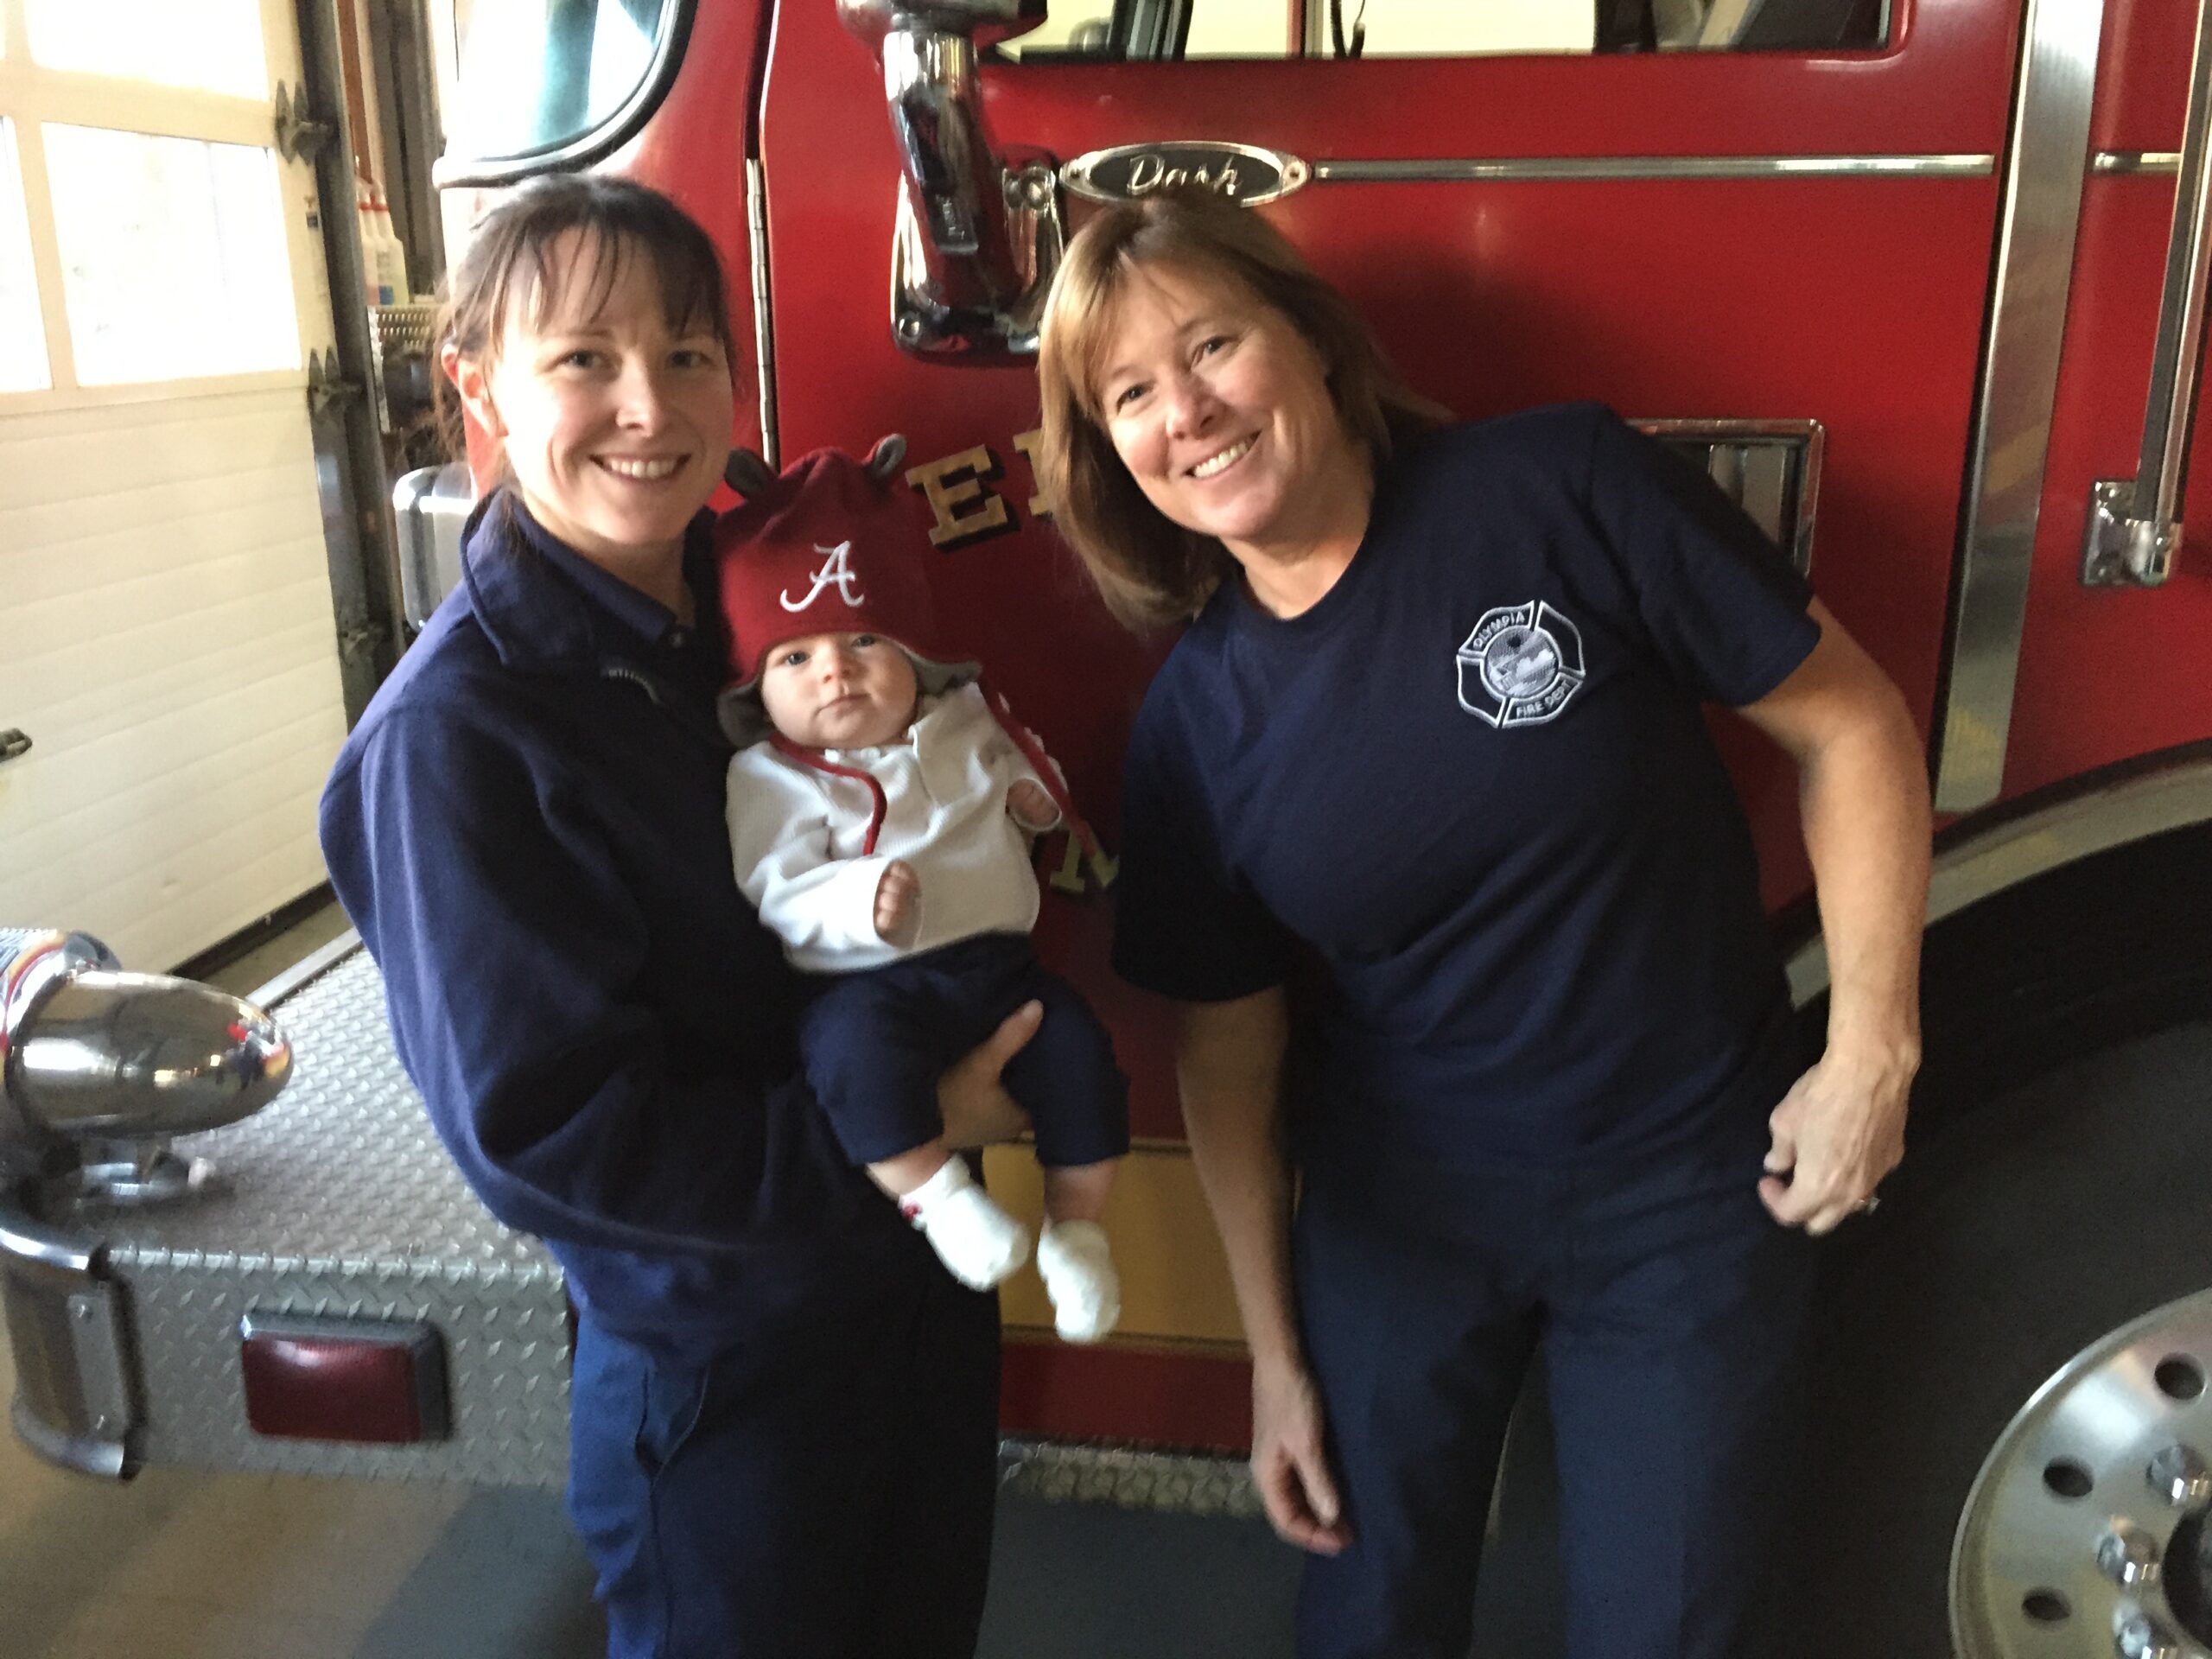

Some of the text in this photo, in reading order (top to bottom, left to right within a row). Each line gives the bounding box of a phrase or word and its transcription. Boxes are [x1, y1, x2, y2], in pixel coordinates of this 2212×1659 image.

[780, 540, 864, 613] A
[1472, 611, 1526, 649] OLYMPIA
[1516, 701, 1545, 719] FIRE
